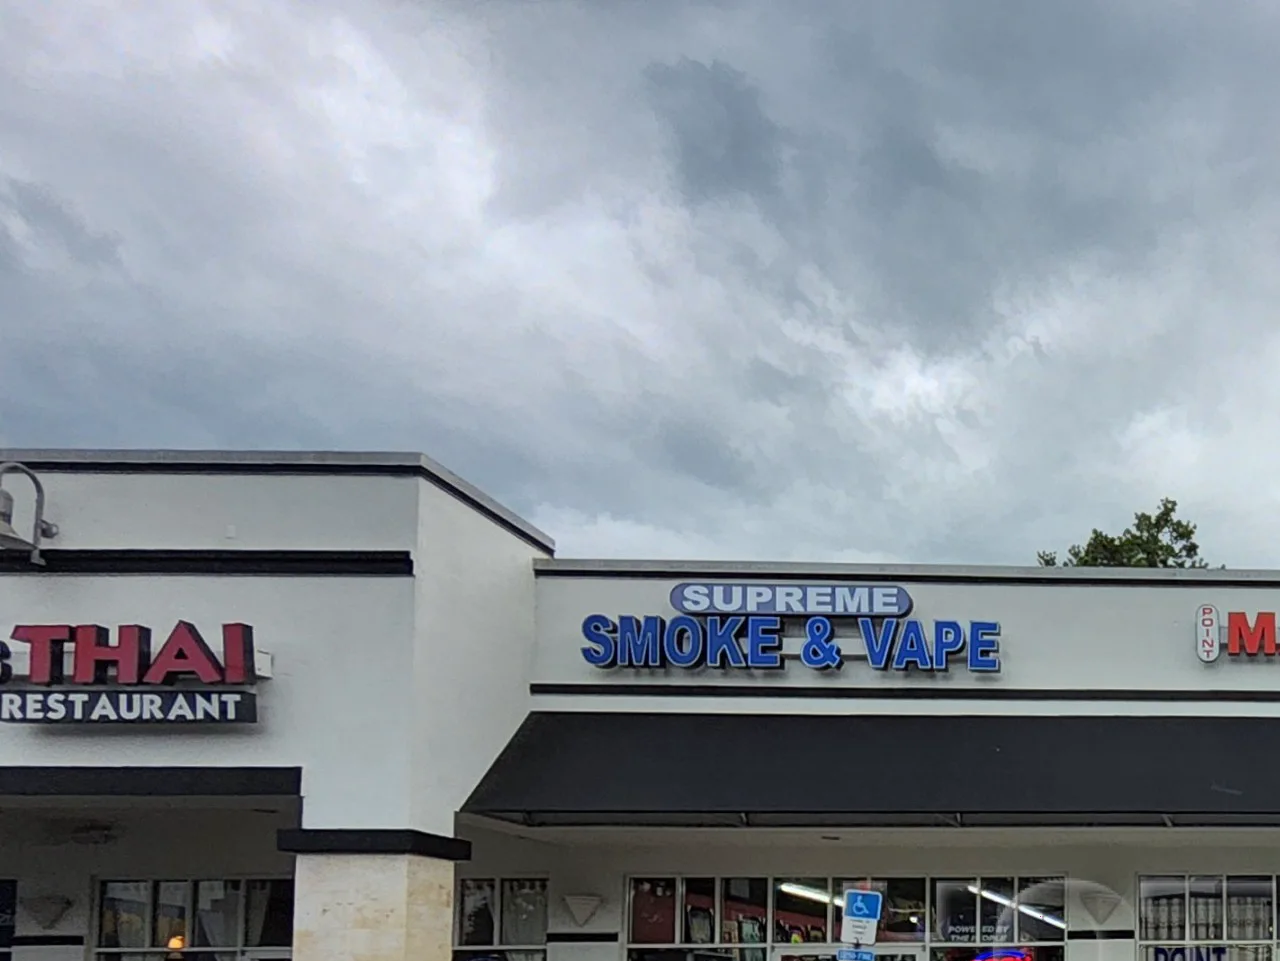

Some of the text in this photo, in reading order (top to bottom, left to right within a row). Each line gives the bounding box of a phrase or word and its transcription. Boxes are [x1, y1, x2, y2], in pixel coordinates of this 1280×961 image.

[682, 586, 899, 614] SUPREME
[10, 620, 254, 685] THAI
[581, 614, 1001, 672] SMOKE & VAPE
[1201, 607, 1215, 659] POINT
[2, 694, 242, 720] RESTAURANT
[948, 925, 994, 933] POWEED
